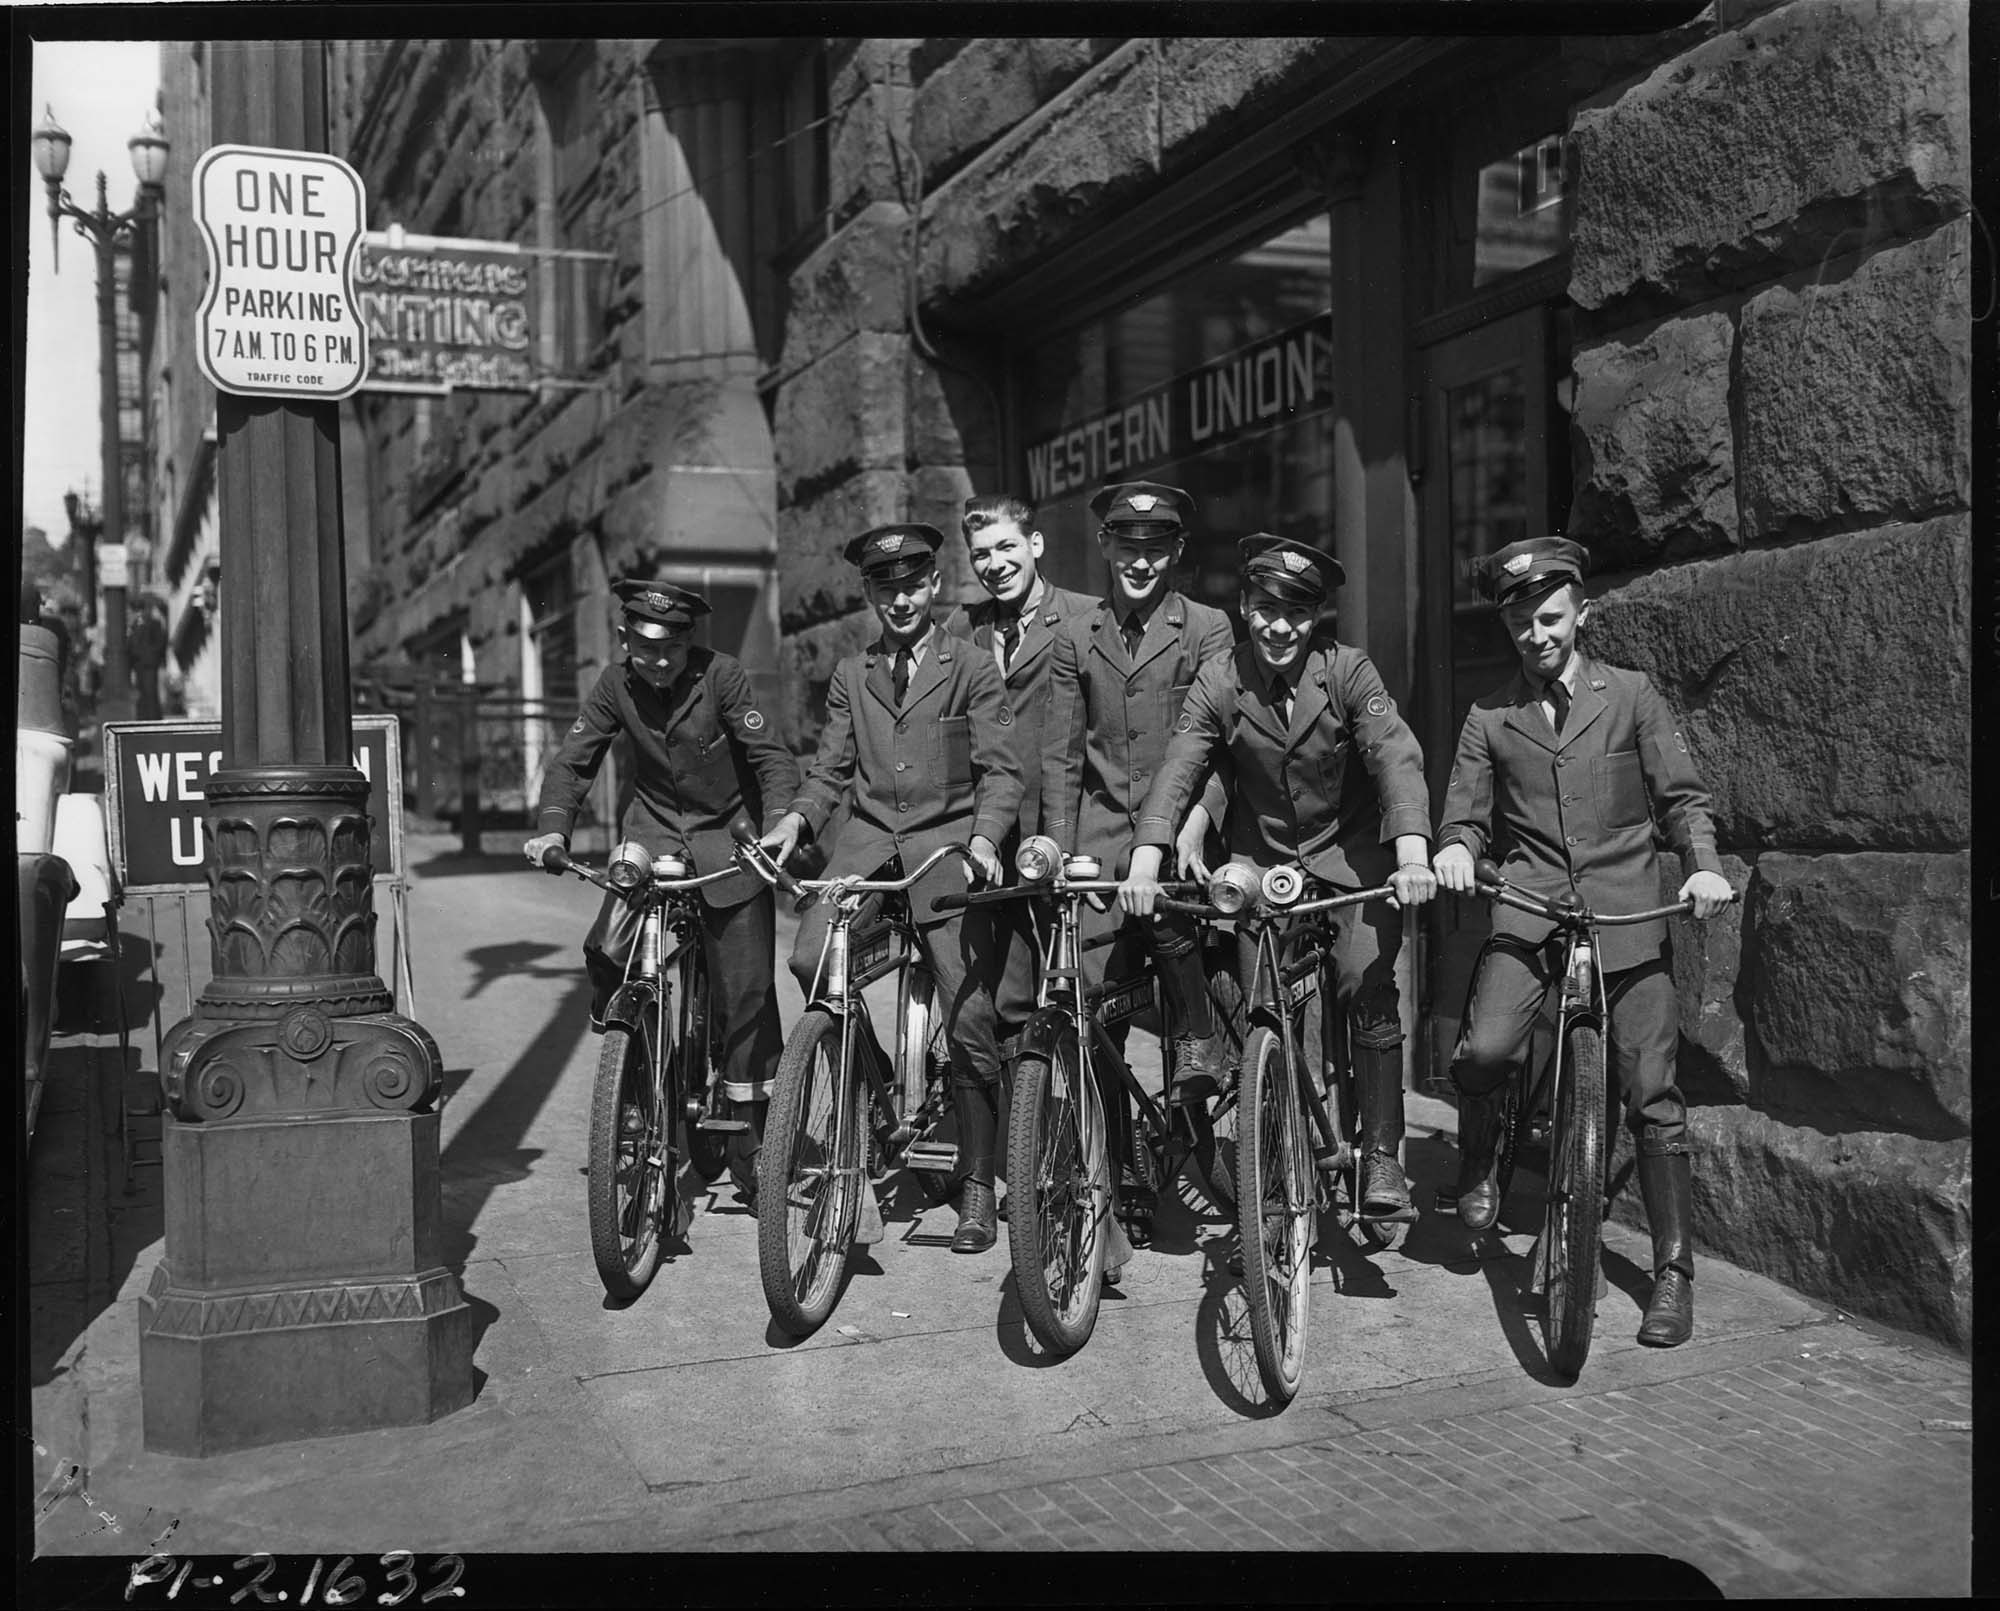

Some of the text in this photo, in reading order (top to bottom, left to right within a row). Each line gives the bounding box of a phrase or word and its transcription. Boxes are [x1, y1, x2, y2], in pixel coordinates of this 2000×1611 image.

[236, 169, 325, 218] ONE
[225, 224, 337, 274] HOUR
[225, 287, 342, 323] PARKING
[215, 329, 357, 365] 7 A.M. TO 6 P.M.
[247, 372, 324, 385] TRAFFIC CODE
[1027, 331, 1314, 501] WESTERN UNION
